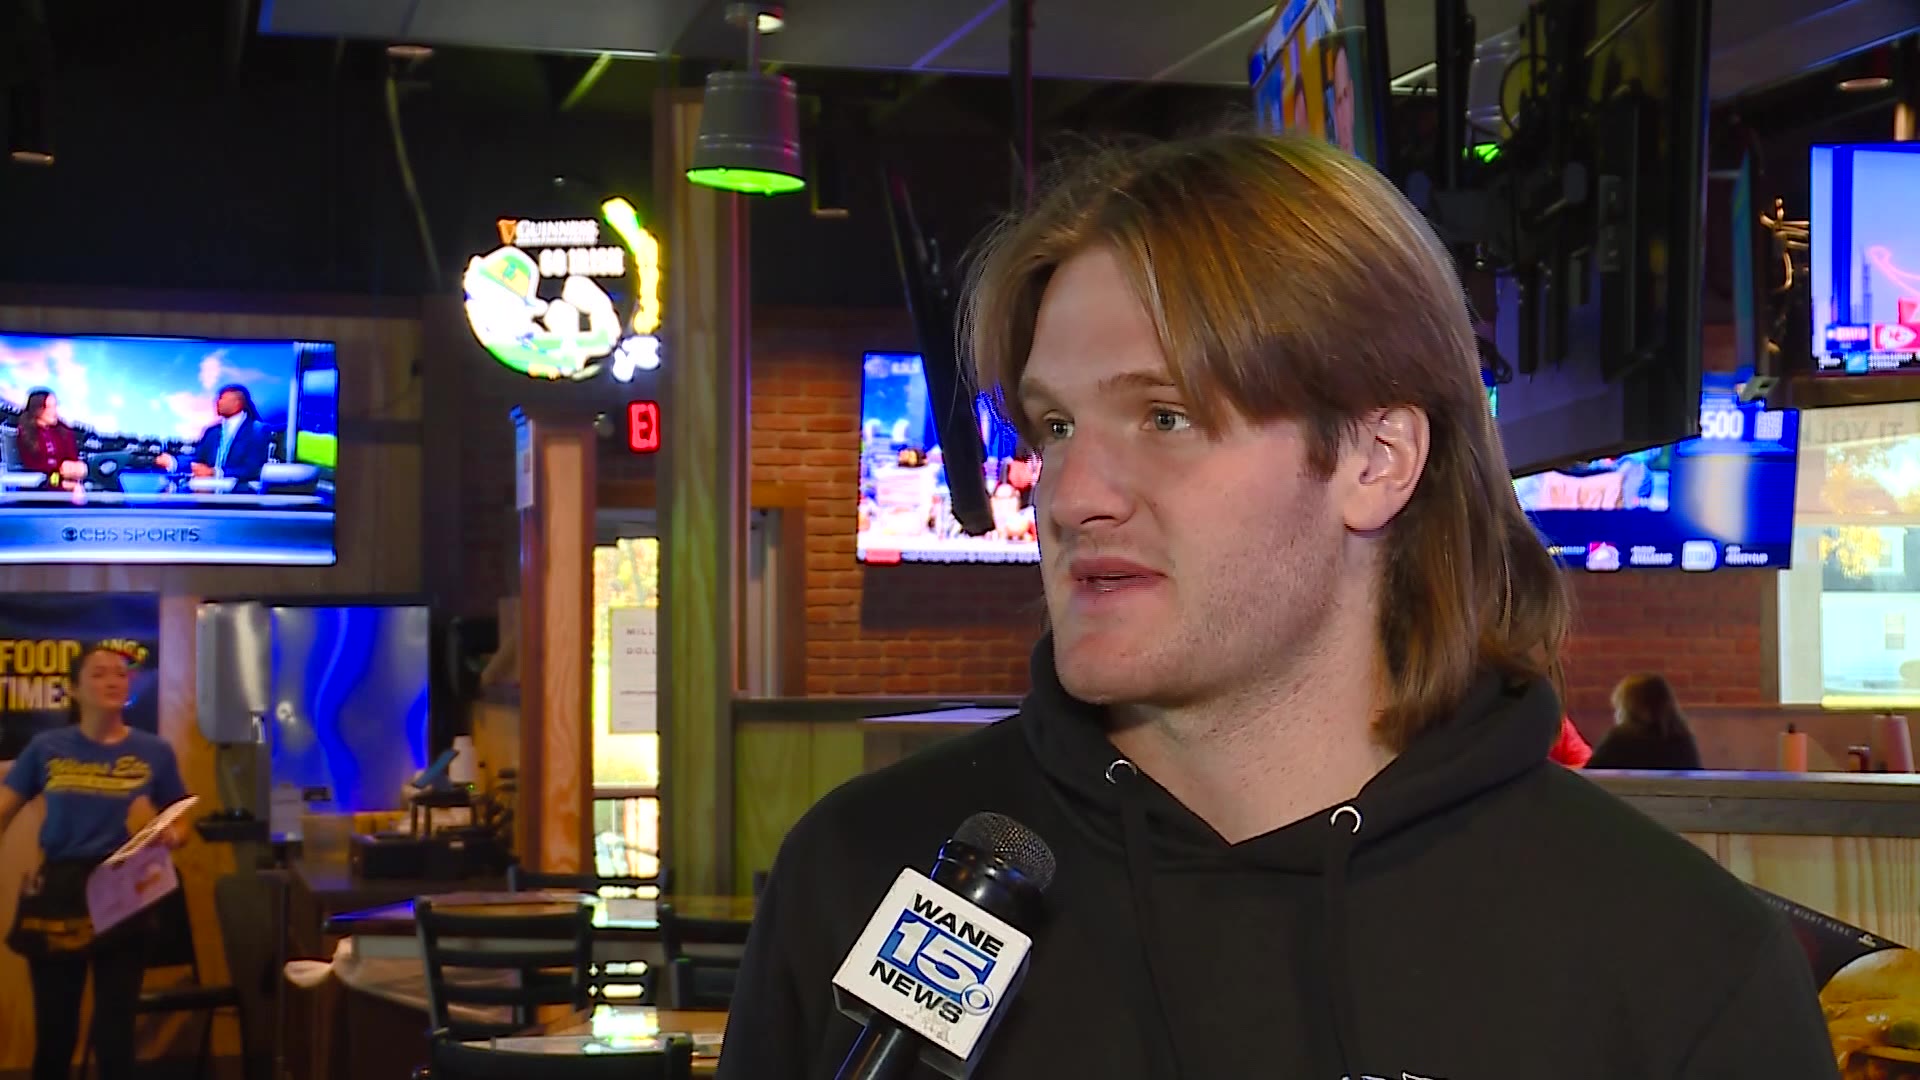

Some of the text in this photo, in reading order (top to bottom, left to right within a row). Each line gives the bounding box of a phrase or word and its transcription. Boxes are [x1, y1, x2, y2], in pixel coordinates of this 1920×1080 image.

[80, 527, 200, 543] CBS SPORTS
[626, 627, 654, 636] MILL
[892, 920, 989, 995] 15
[913, 893, 1004, 958] WANE
[869, 959, 964, 1024] NEWS
